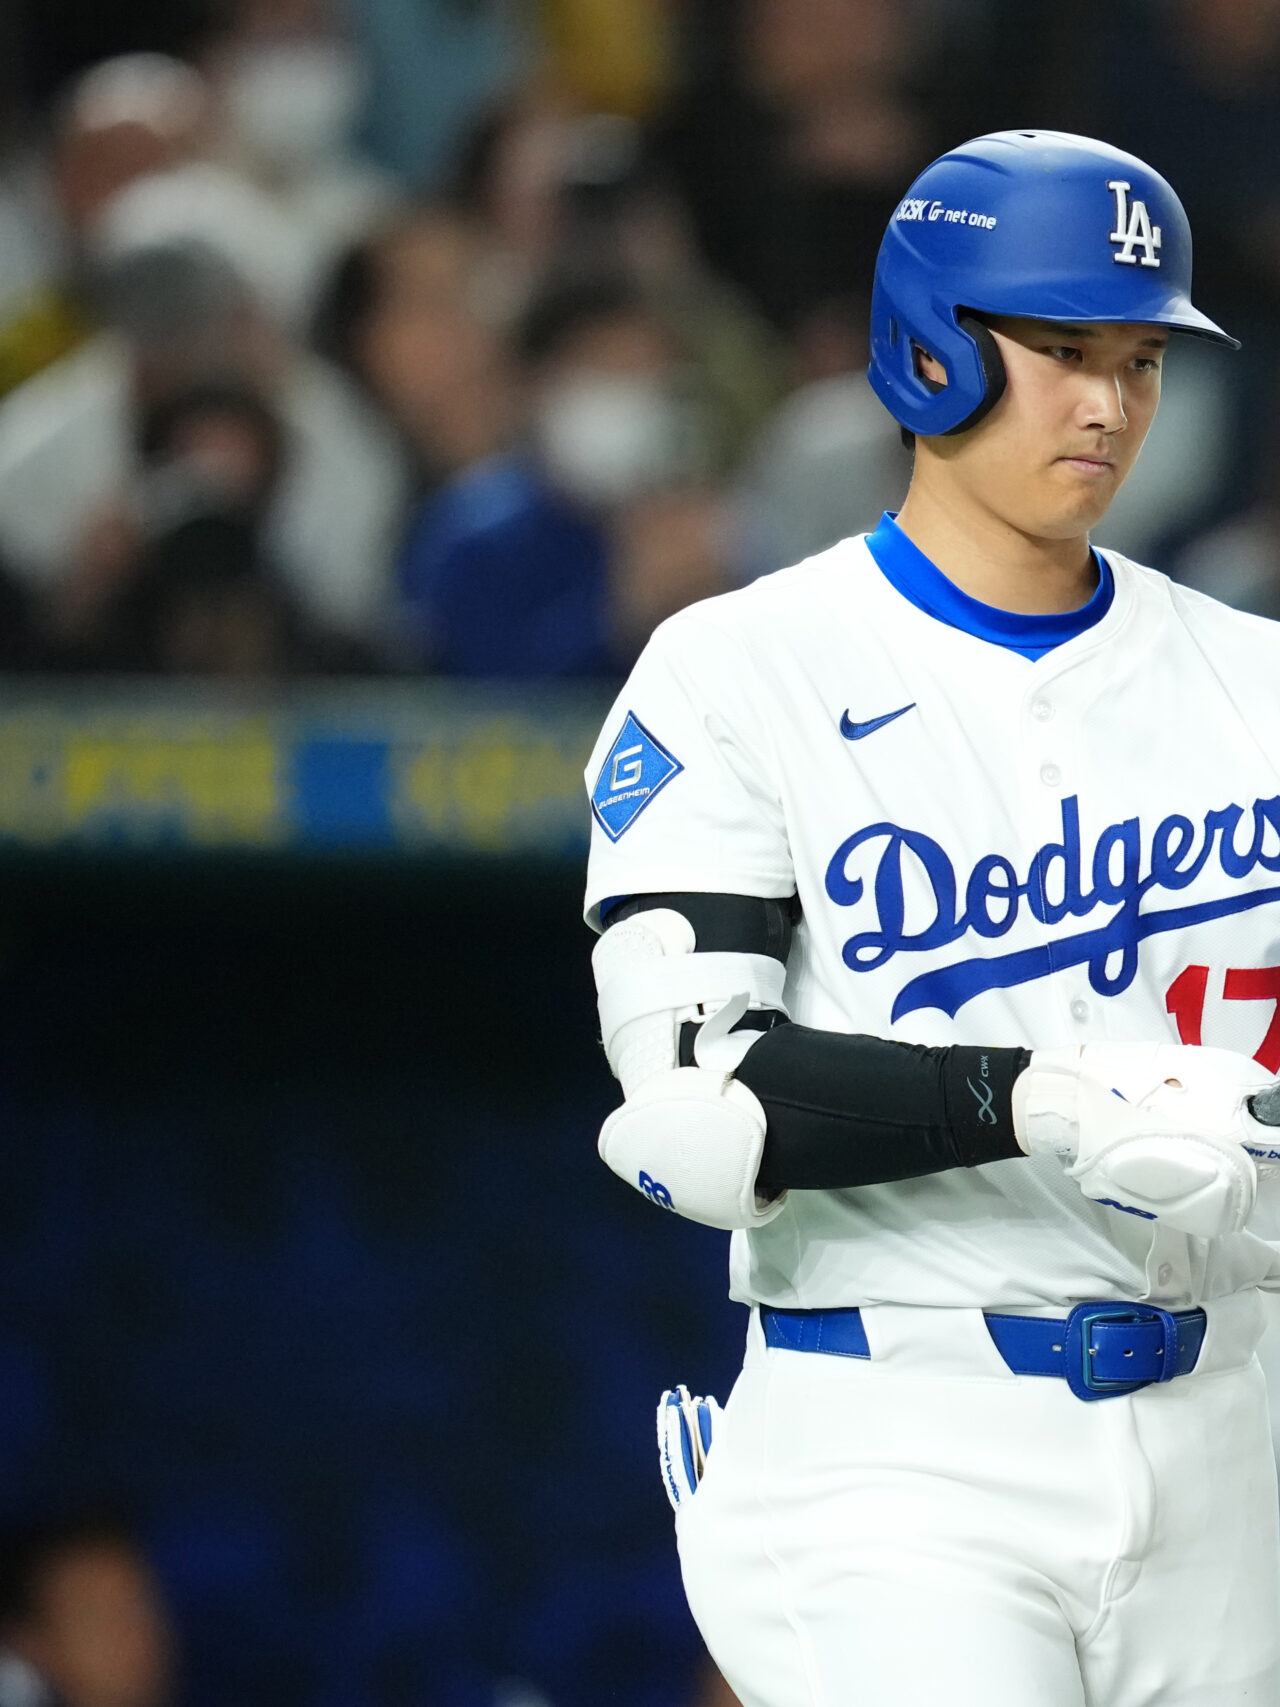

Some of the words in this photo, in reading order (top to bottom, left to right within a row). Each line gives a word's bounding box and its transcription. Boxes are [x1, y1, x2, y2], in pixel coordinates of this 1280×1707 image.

[945, 209, 968, 224] net
[968, 213, 997, 230] one
[1108, 180, 1161, 267] LA
[610, 743, 643, 791] G
